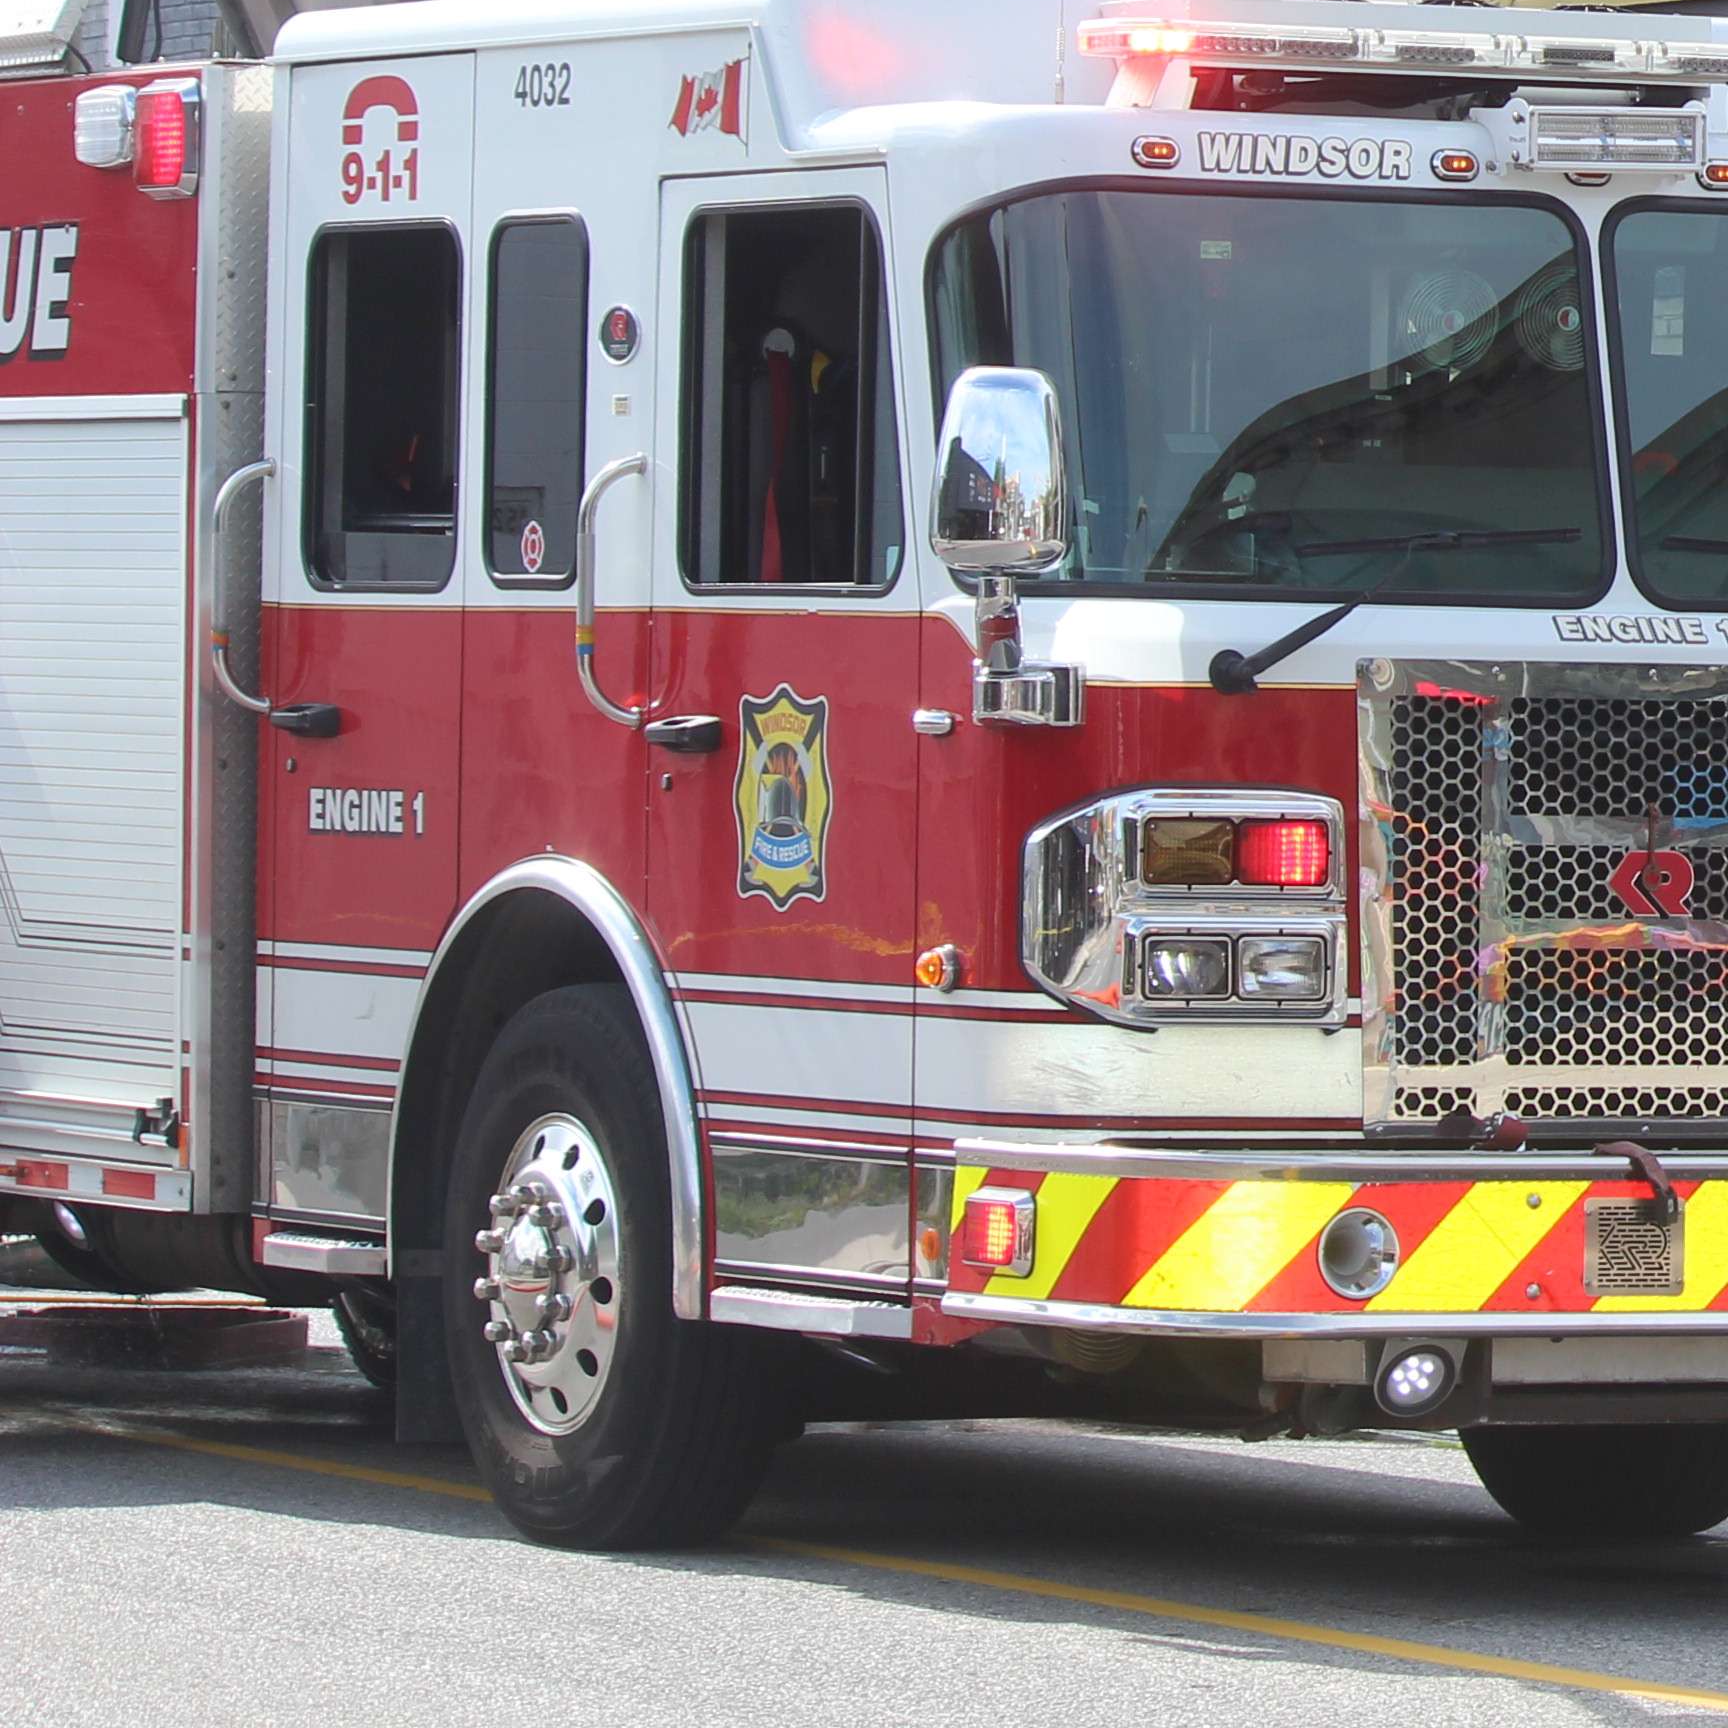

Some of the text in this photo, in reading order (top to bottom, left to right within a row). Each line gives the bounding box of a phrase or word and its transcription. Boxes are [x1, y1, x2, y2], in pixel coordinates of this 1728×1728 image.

[514, 62, 571, 107] 4032
[341, 147, 418, 205] 9-1-1
[1198, 132, 1412, 180] WINDSOR
[1553, 615, 1708, 644] ENGINE
[762, 713, 807, 736] WINDSOR
[309, 788, 424, 834] ENGINE 1
